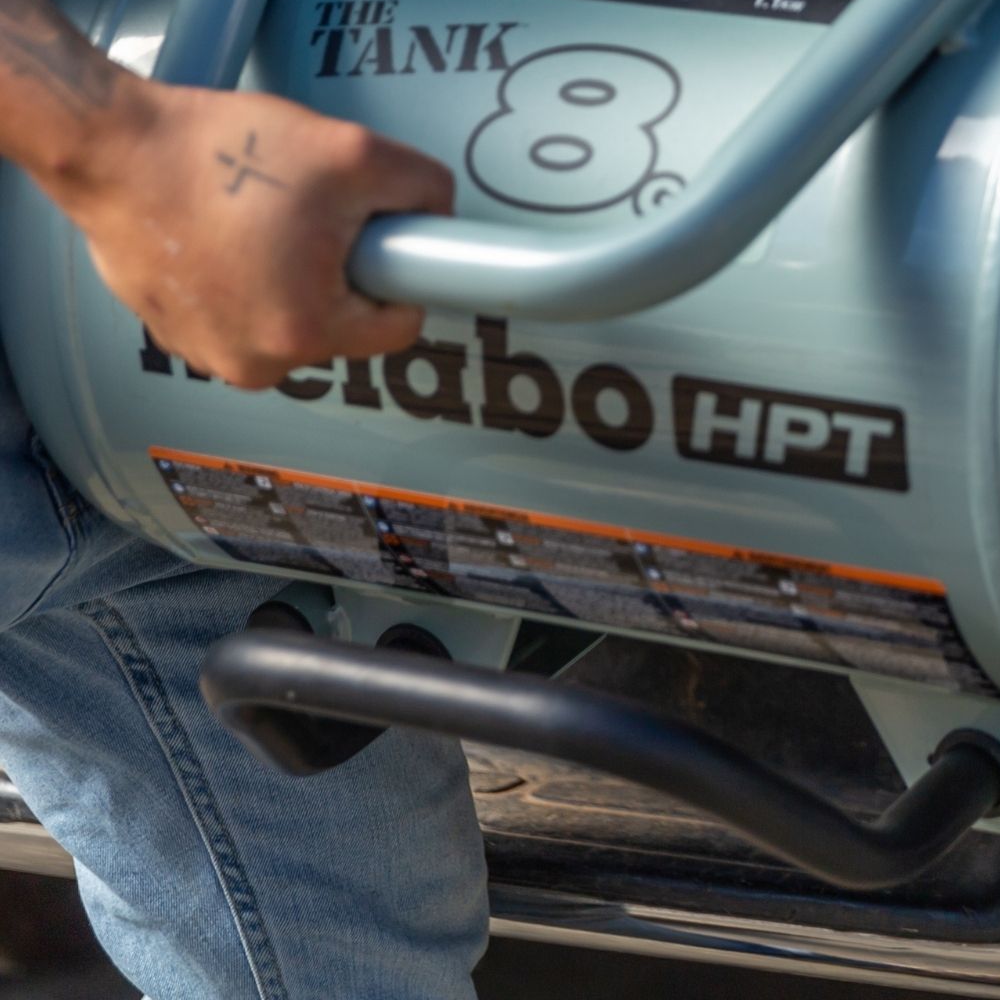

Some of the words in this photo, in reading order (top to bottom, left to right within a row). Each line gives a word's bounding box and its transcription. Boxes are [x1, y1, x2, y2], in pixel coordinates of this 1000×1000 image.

[310, 21, 520, 78] TANK
[464, 43, 683, 215] 8
[690, 391, 895, 477] HPT
